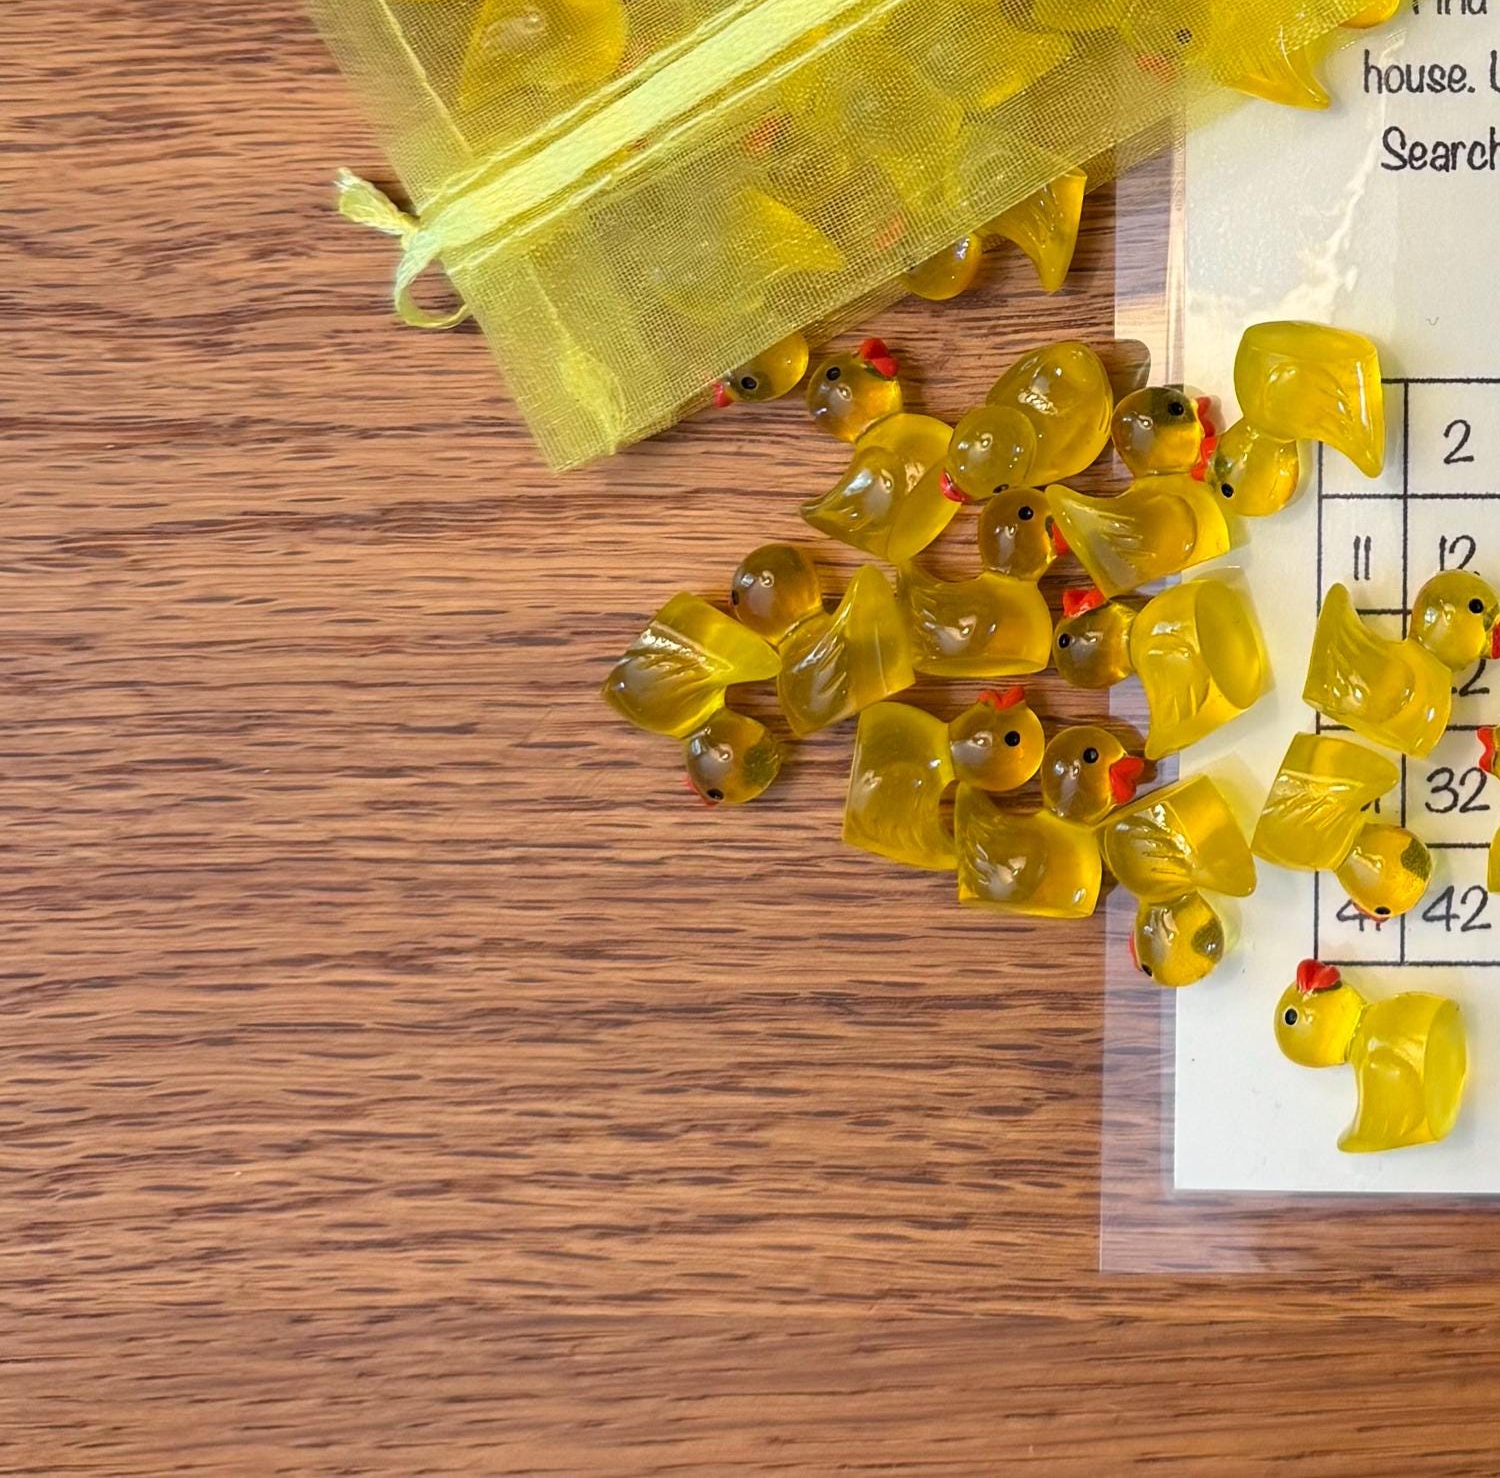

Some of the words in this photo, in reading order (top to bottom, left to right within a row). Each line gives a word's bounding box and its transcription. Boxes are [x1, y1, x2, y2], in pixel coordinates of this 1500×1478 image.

[1364, 49, 1475, 94] house.
[1443, 419, 1474, 465] 2
[1353, 536, 1371, 581] 11
[1439, 535, 1480, 575] 12
[1452, 658, 1490, 697] 2
[1425, 766, 1491, 814] 32
[1336, 898, 1381, 932] 4
[1421, 884, 1492, 933] 42
